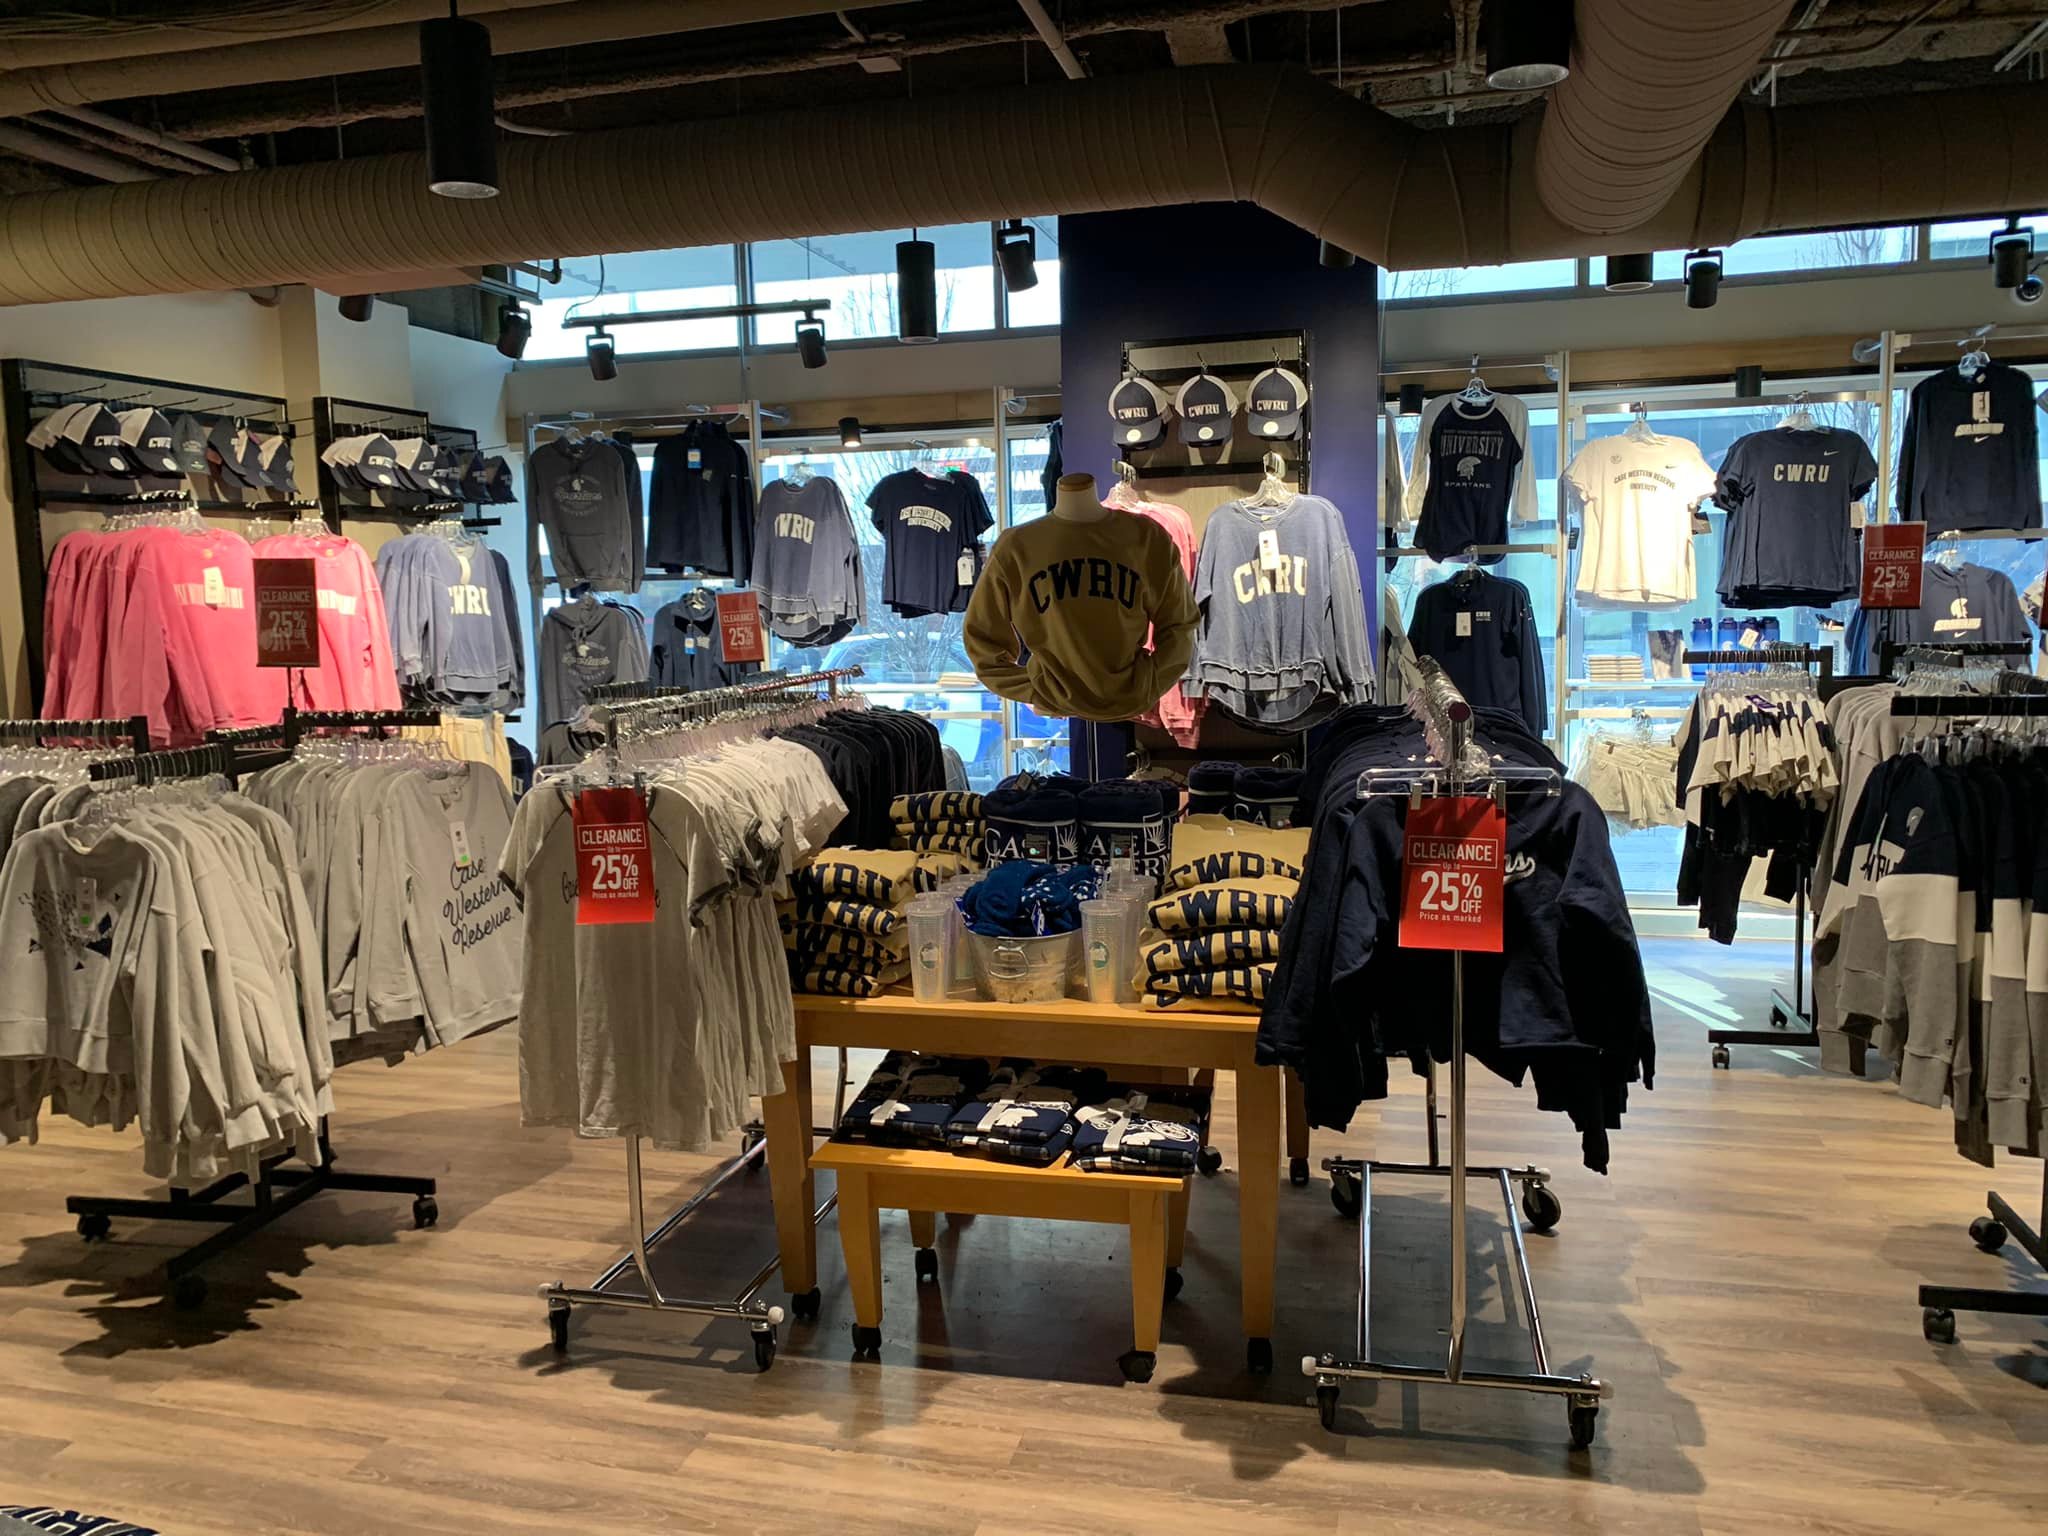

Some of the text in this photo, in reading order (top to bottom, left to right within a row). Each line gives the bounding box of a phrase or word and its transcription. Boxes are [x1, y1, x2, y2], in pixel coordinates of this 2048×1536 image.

[1118, 407, 1148, 419] CWRU
[1188, 404, 1220, 417] CWRU
[1257, 400, 1288, 411] CWRU
[1441, 434, 1504, 459] UNIVERSITY
[1773, 463, 1830, 482] CWRU
[1869, 549, 1917, 560] CLEARANCE
[1028, 557, 1142, 615] CWRU
[1873, 565, 1910, 589] 25%
[582, 829, 642, 845] CLEARANCE
[1412, 842, 1493, 862] CLEARANCE
[450, 858, 484, 891] Case
[591, 853, 639, 890] 25%
[1442, 861, 1461, 871] Up to
[623, 877, 639, 890] OFF
[1420, 870, 1483, 912] 25%
[442, 879, 507, 927] Western
[1461, 899, 1482, 914] OFF
[1420, 911, 1439, 921] Price
[1453, 913, 1482, 923] marked
[452, 906, 512, 955] Reserve
